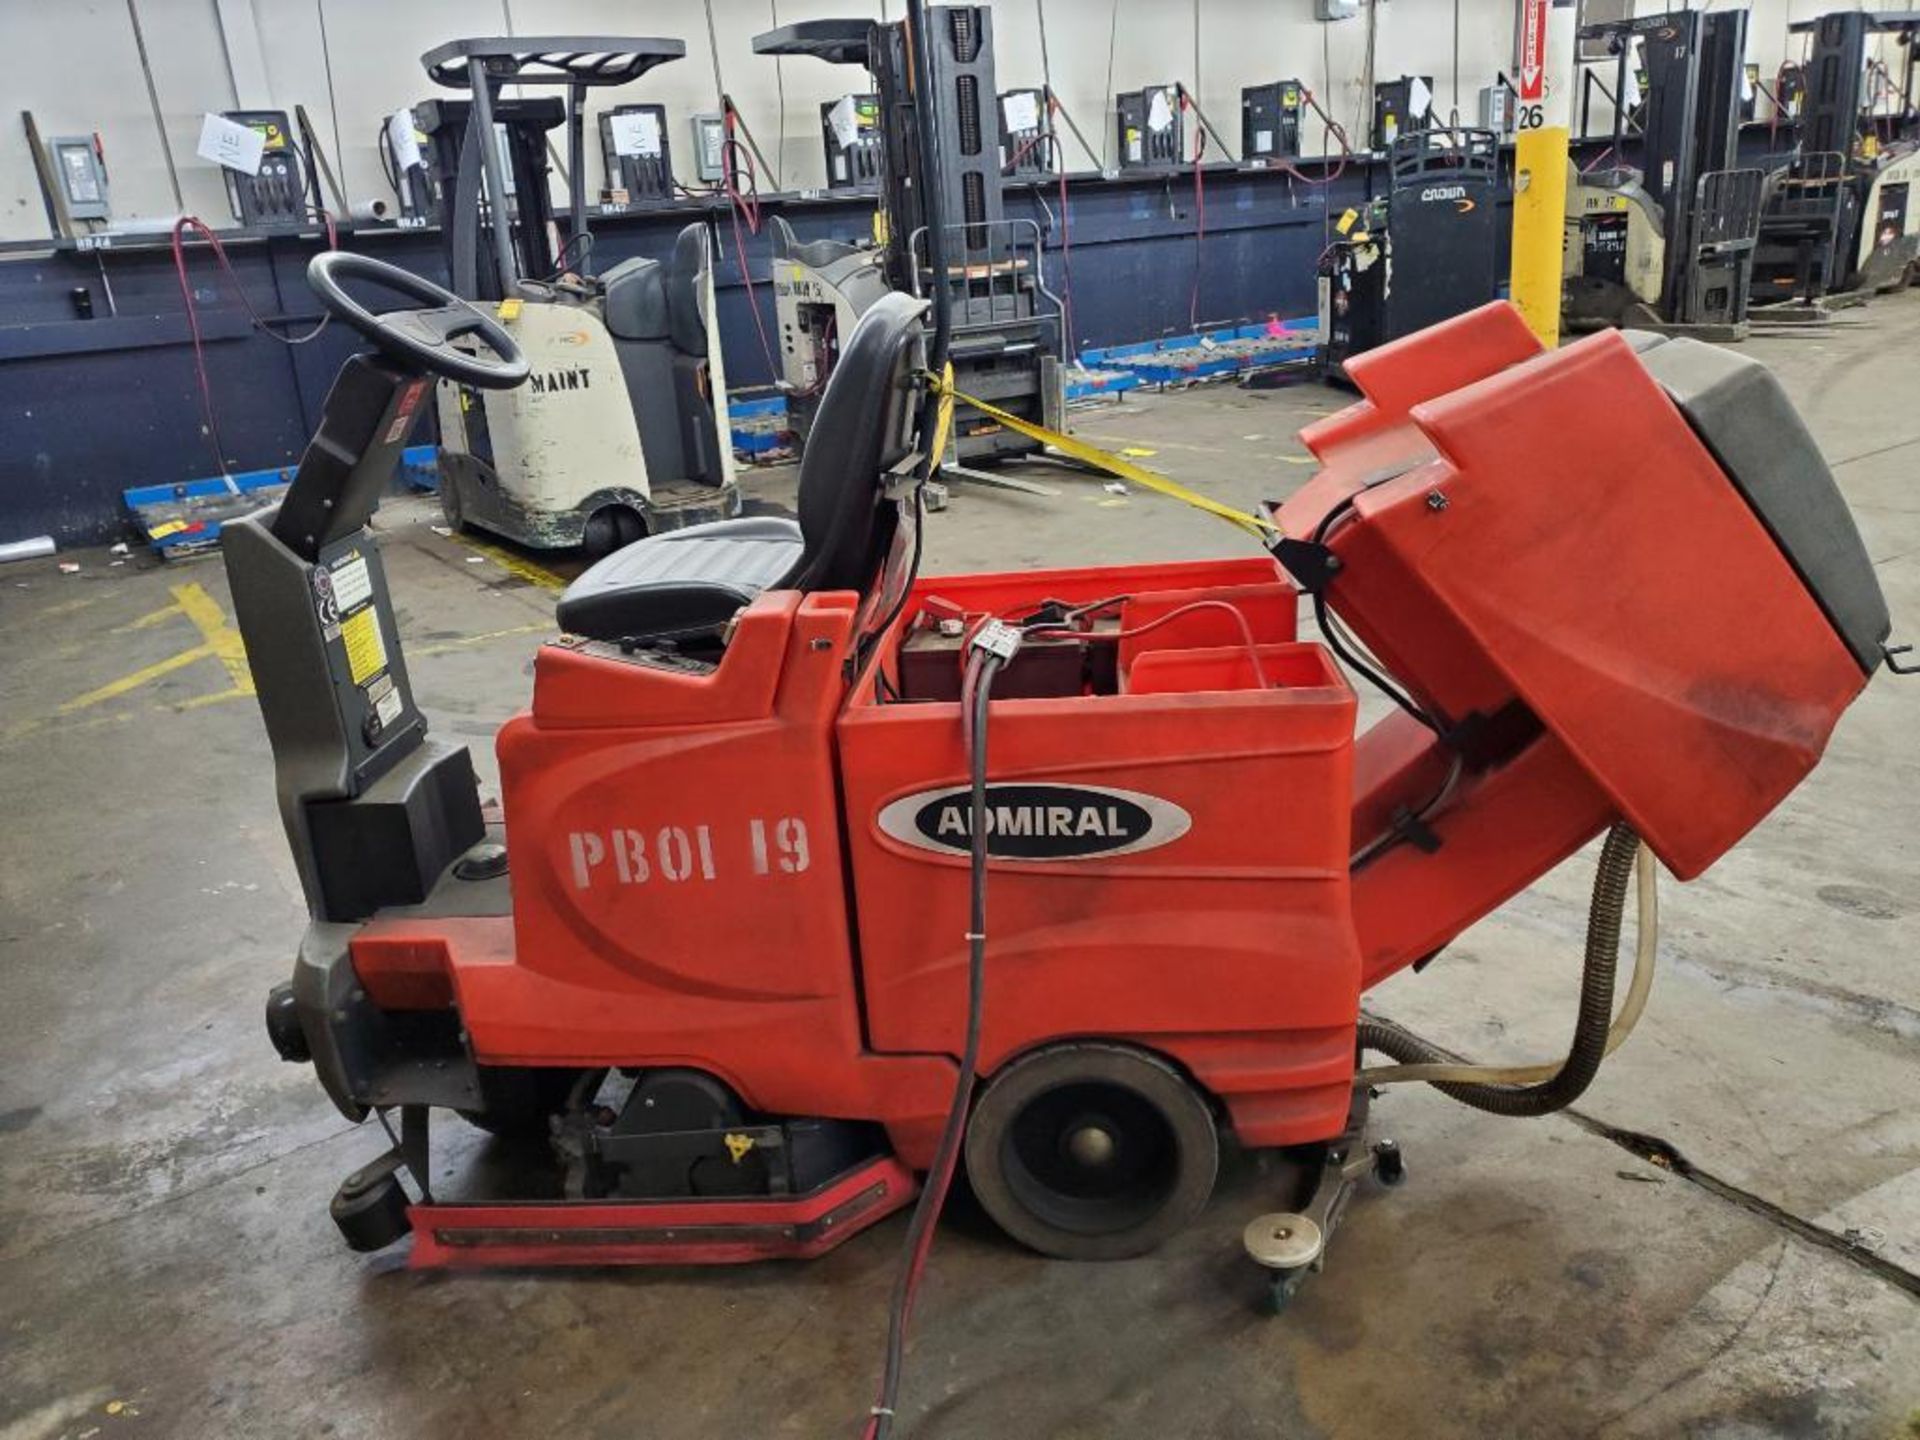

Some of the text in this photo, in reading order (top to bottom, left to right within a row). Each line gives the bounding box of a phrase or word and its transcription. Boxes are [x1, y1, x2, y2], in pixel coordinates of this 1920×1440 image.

[1518, 104, 1544, 129] 26
[1421, 186, 1466, 202] CROWN
[529, 368, 590, 393] MAINT
[937, 806, 1127, 837] ADMIRAL
[750, 817, 811, 876] 19
